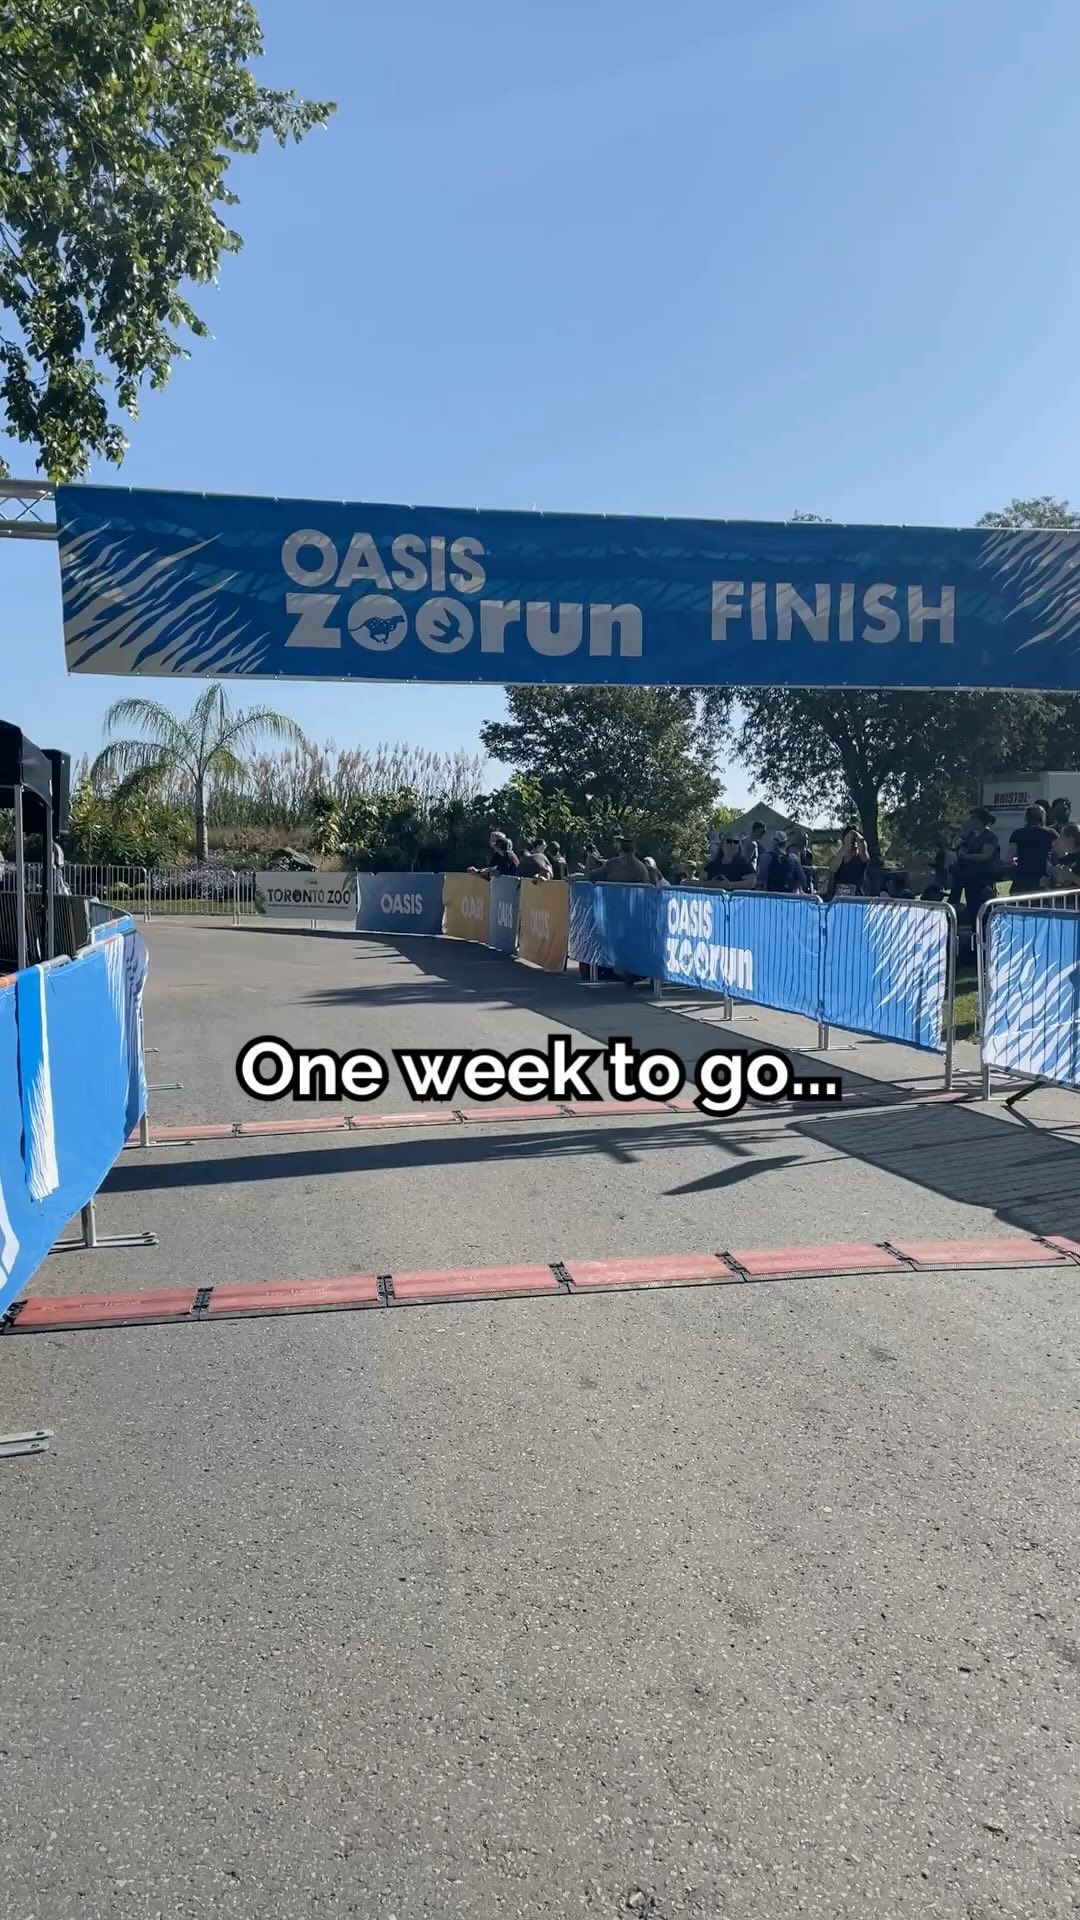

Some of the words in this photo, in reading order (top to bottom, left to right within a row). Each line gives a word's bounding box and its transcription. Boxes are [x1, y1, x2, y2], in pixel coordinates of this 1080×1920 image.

[281, 528, 487, 594] OASIS
[711, 581, 955, 643] FINISH
[267, 889, 325, 903] TORONTO
[327, 890, 350, 904] ZOO
[380, 893, 423, 914] OASIS
[667, 898, 713, 939] OASIS
